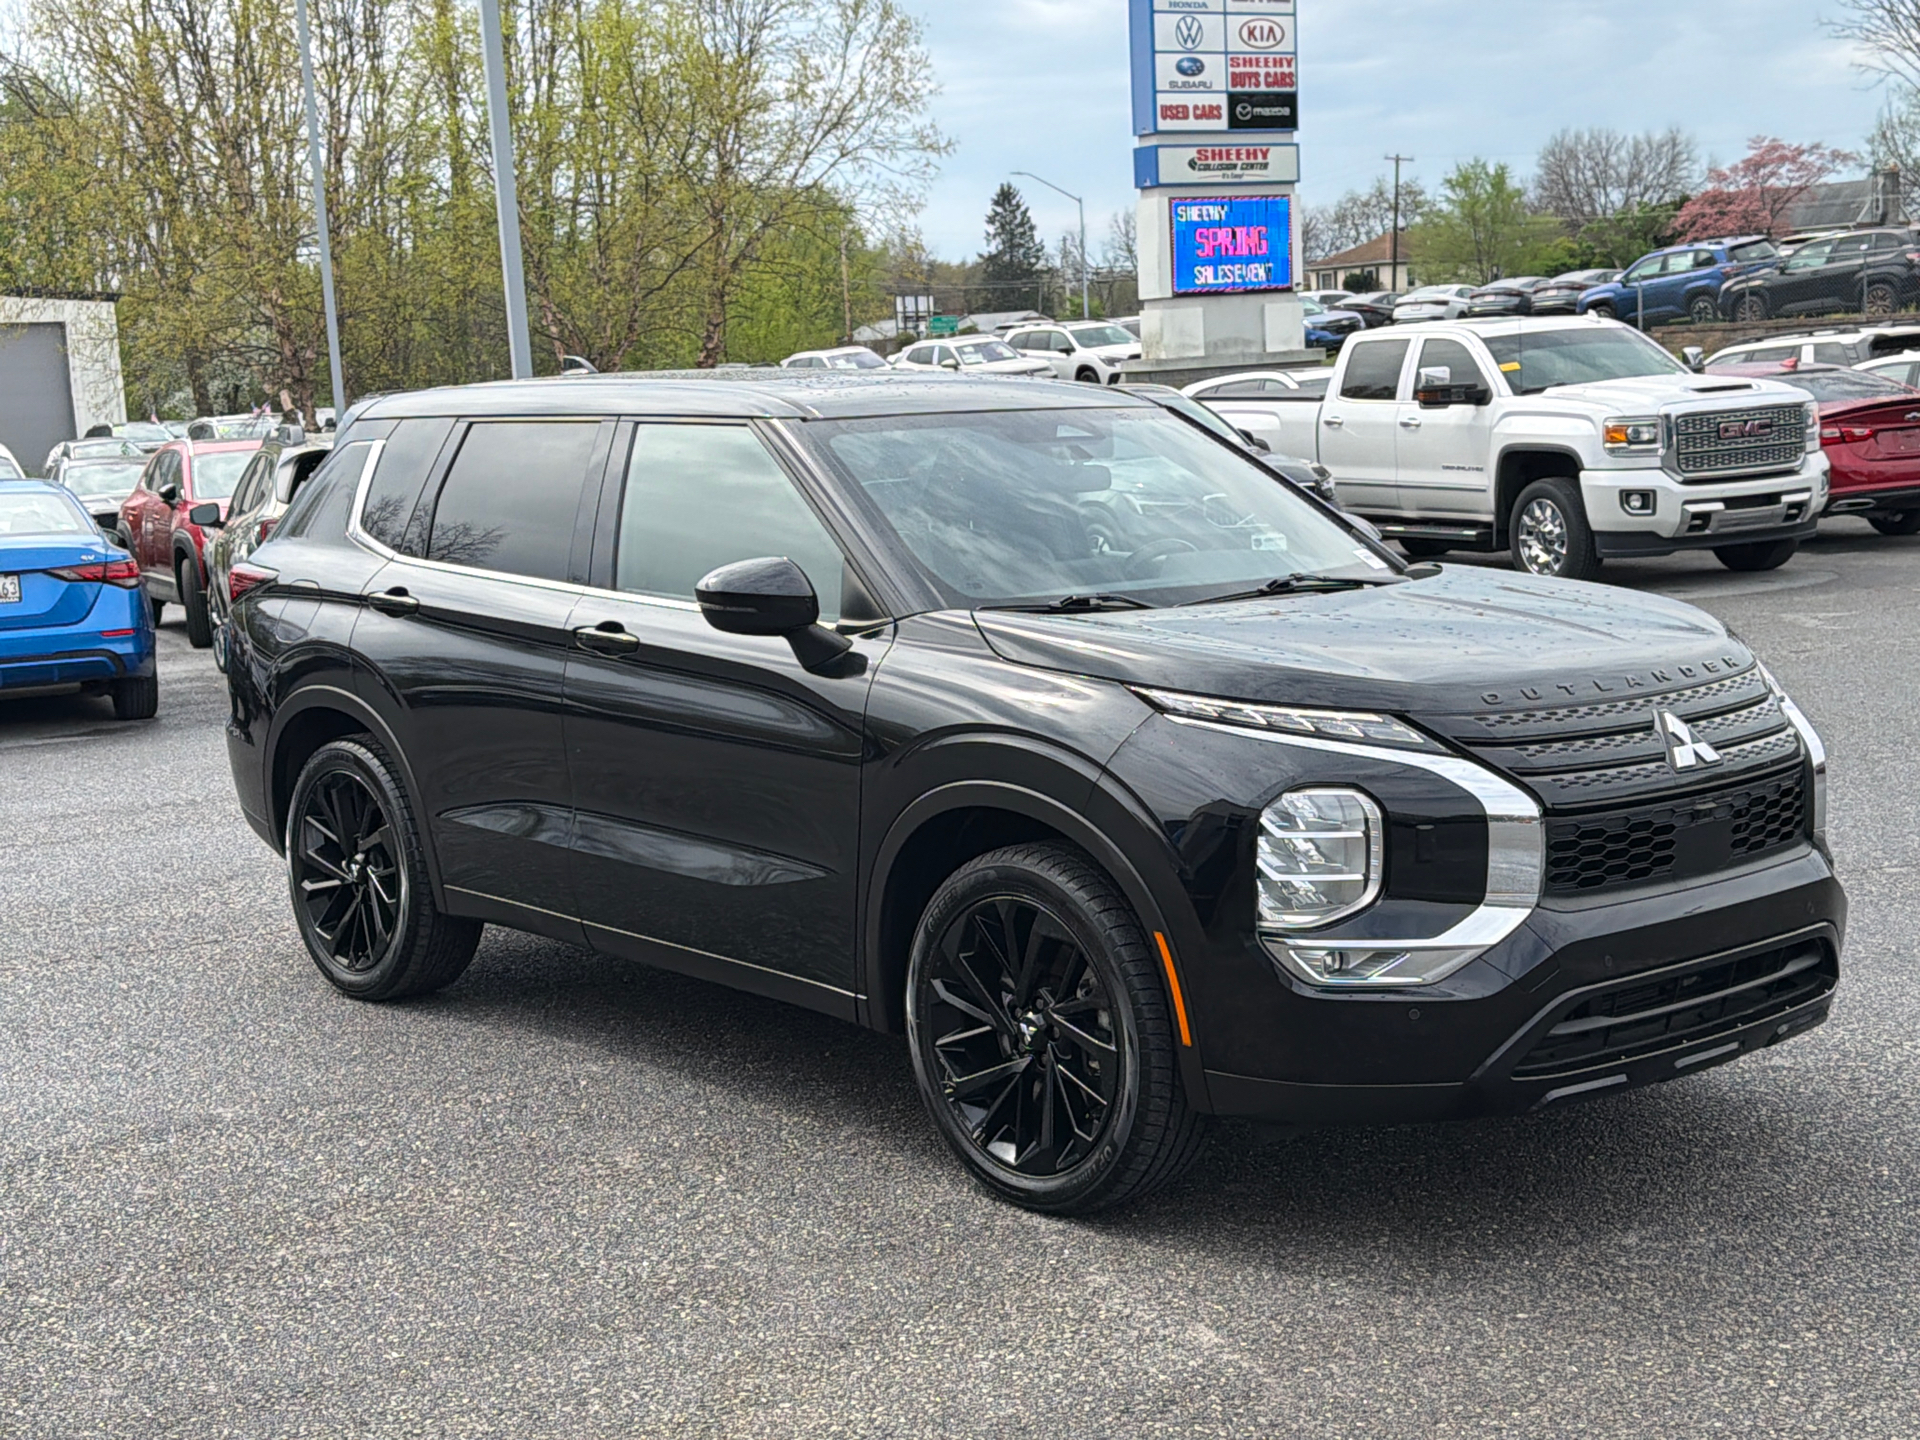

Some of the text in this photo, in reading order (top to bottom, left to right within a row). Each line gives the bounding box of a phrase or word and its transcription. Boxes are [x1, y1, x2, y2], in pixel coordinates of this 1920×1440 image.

[1168, 0, 1209, 9] HONDA
[1247, 25, 1277, 42] KIA
[1229, 57, 1294, 68] SHEEHY
[1168, 80, 1213, 89] SUBARU
[1230, 71, 1295, 88] BUYS CARS
[1160, 104, 1222, 121] USED CARS
[1196, 148, 1271, 161] SHEEHY
[1240, 162, 1269, 170] CENTER
[1177, 205, 1228, 222] SHEEHY
[1195, 226, 1268, 258] SPRING
[1719, 419, 1771, 439] GMC
[1480, 655, 1740, 705] OUTLANDER
